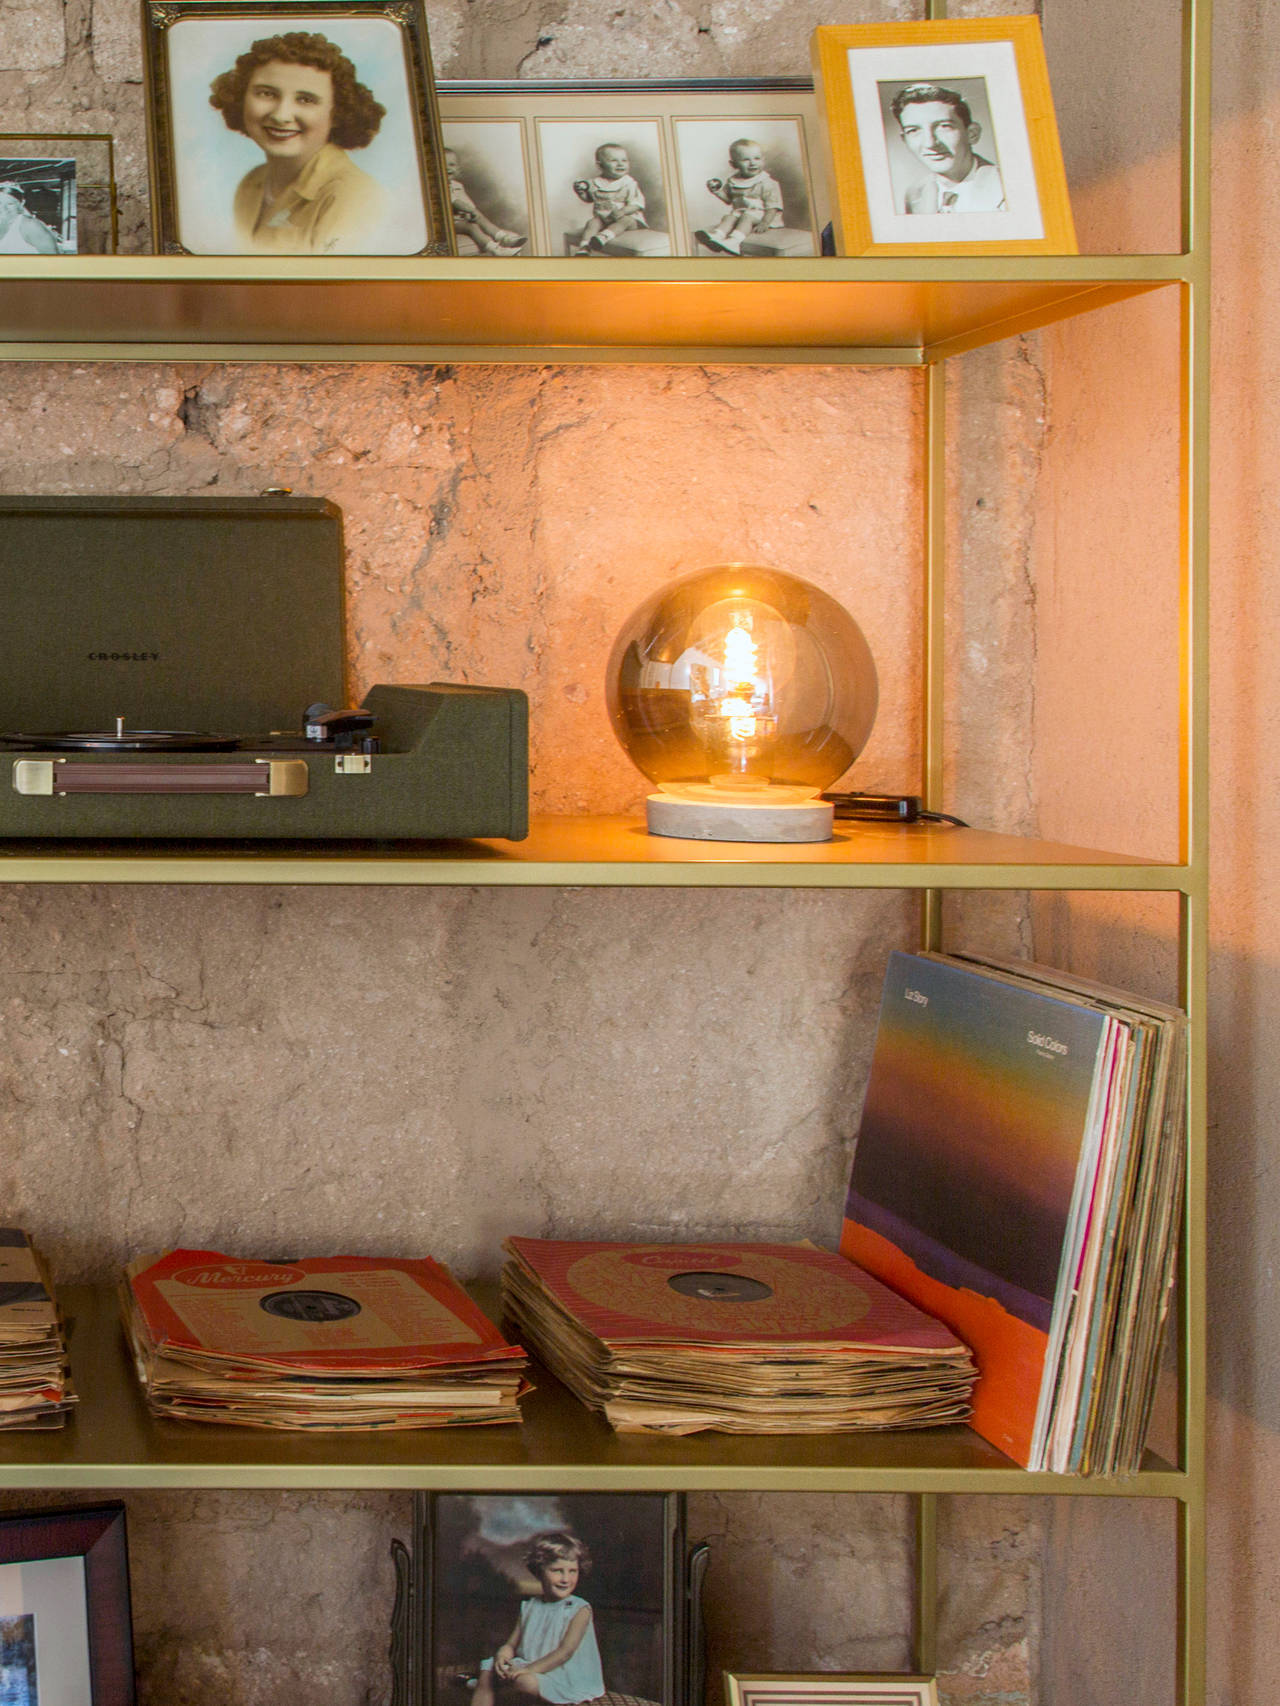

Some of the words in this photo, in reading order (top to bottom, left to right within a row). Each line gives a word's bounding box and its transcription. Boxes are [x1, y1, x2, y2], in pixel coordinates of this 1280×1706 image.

[88, 652, 160, 661] CROSLEY
[1027, 1031, 1046, 1047] Solid
[1045, 1037, 1069, 1056] Colors
[187, 1270, 294, 1284] Mercury
